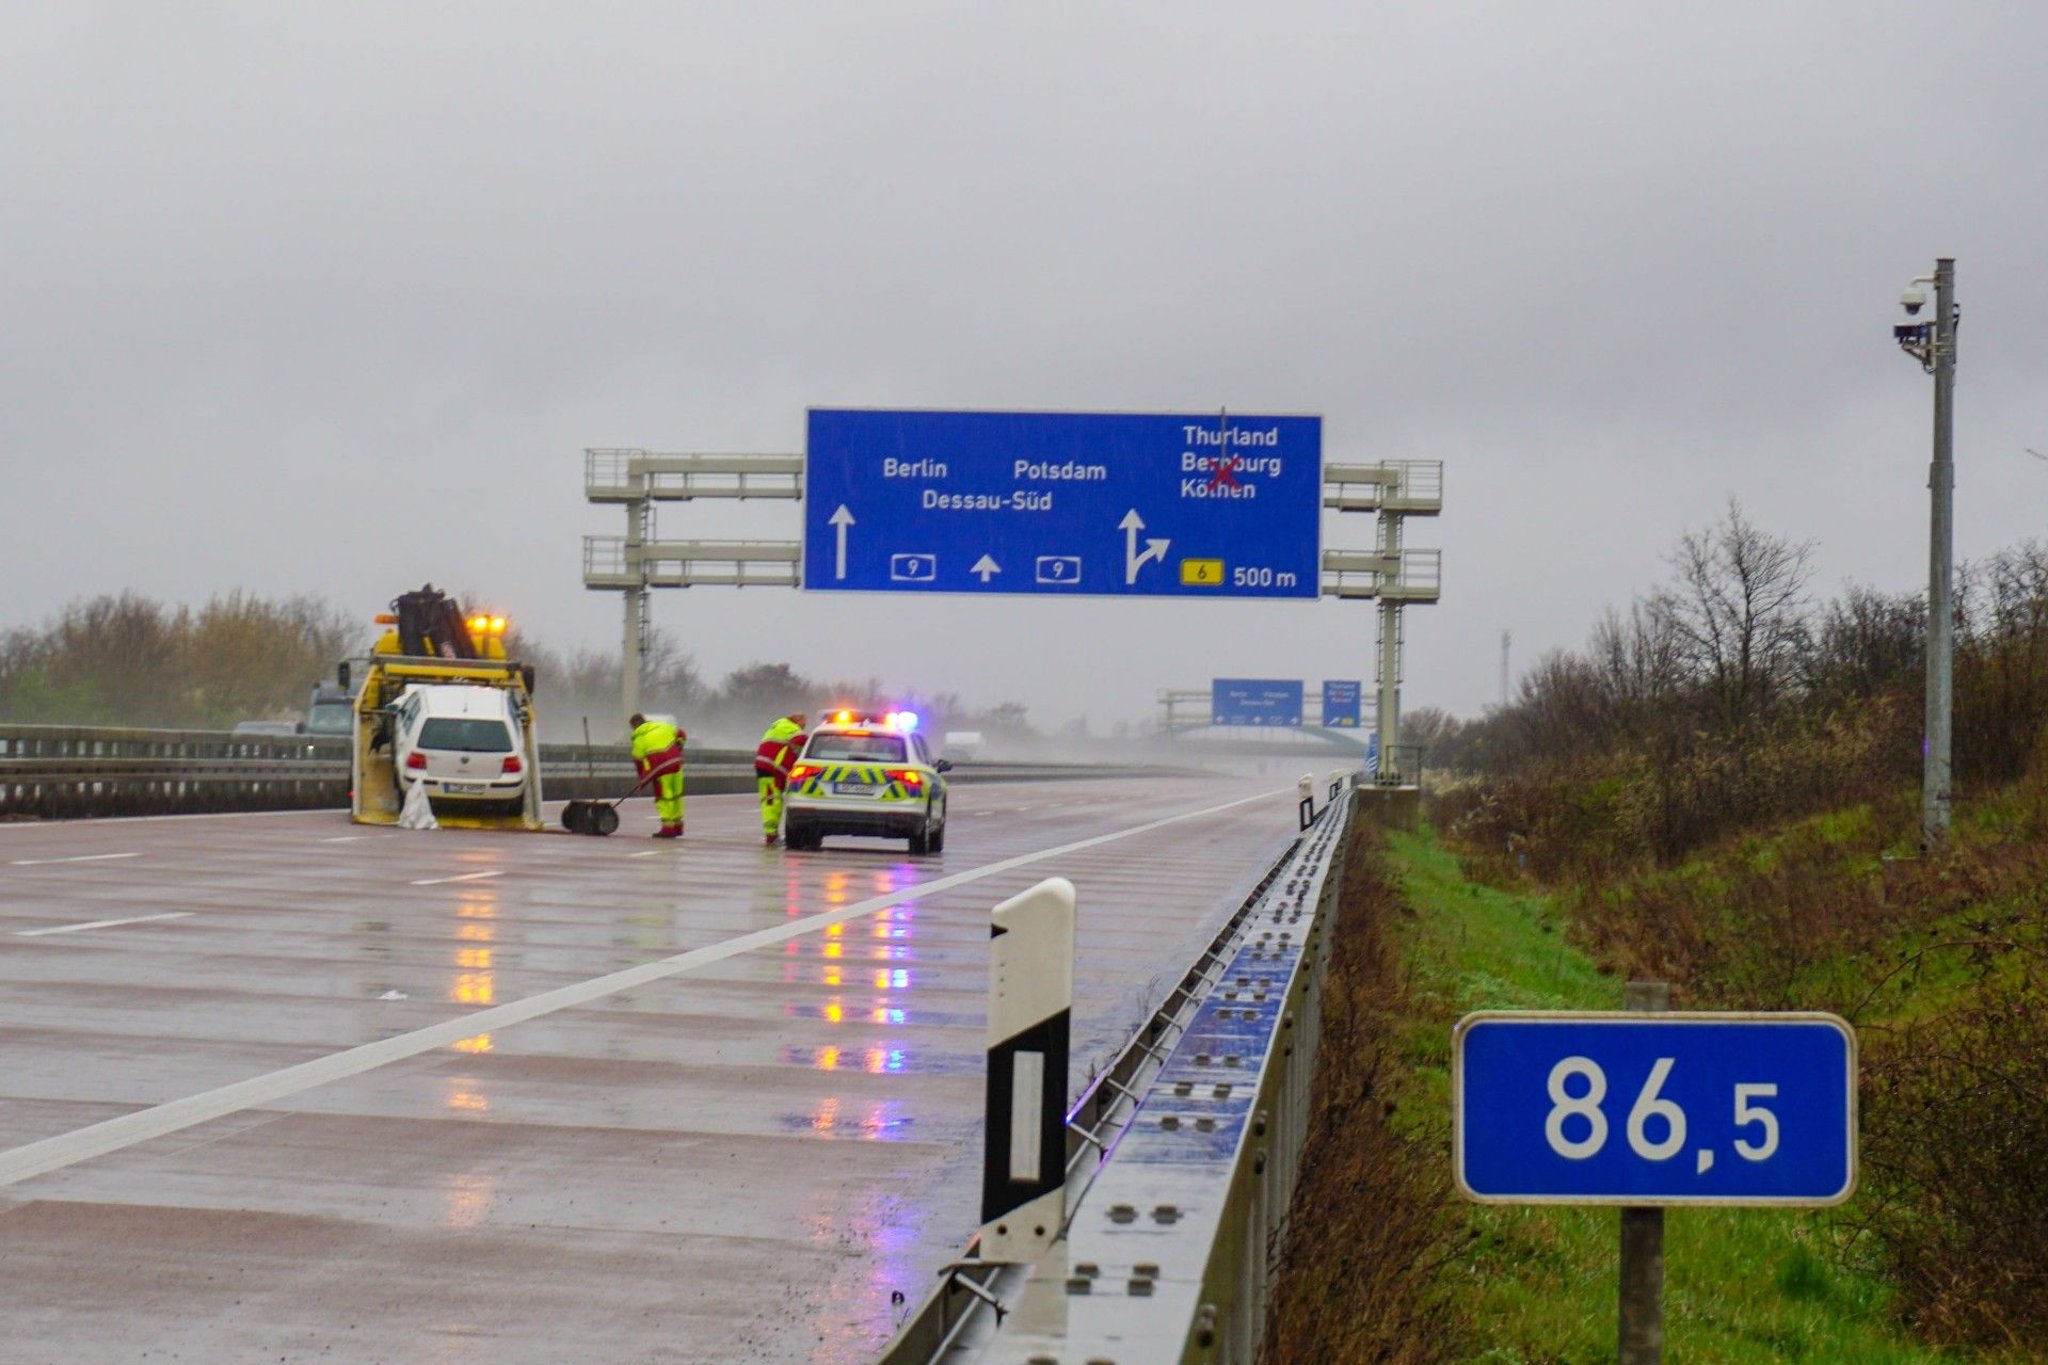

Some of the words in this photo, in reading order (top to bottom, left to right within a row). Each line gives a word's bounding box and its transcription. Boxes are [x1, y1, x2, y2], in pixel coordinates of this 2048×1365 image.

[1183, 426, 1279, 448] Thurland
[884, 458, 947, 478] Berlin
[1014, 460, 1106, 481] Potsdam
[923, 490, 1052, 512] Dessau-Süd
[907, 560, 919, 575] 9
[1052, 561, 1064, 576] 9
[1197, 565, 1208, 580] 6
[1233, 567, 1271, 588] 500
[1277, 572, 1297, 588] m
[1545, 1056, 1780, 1175] 86,5
